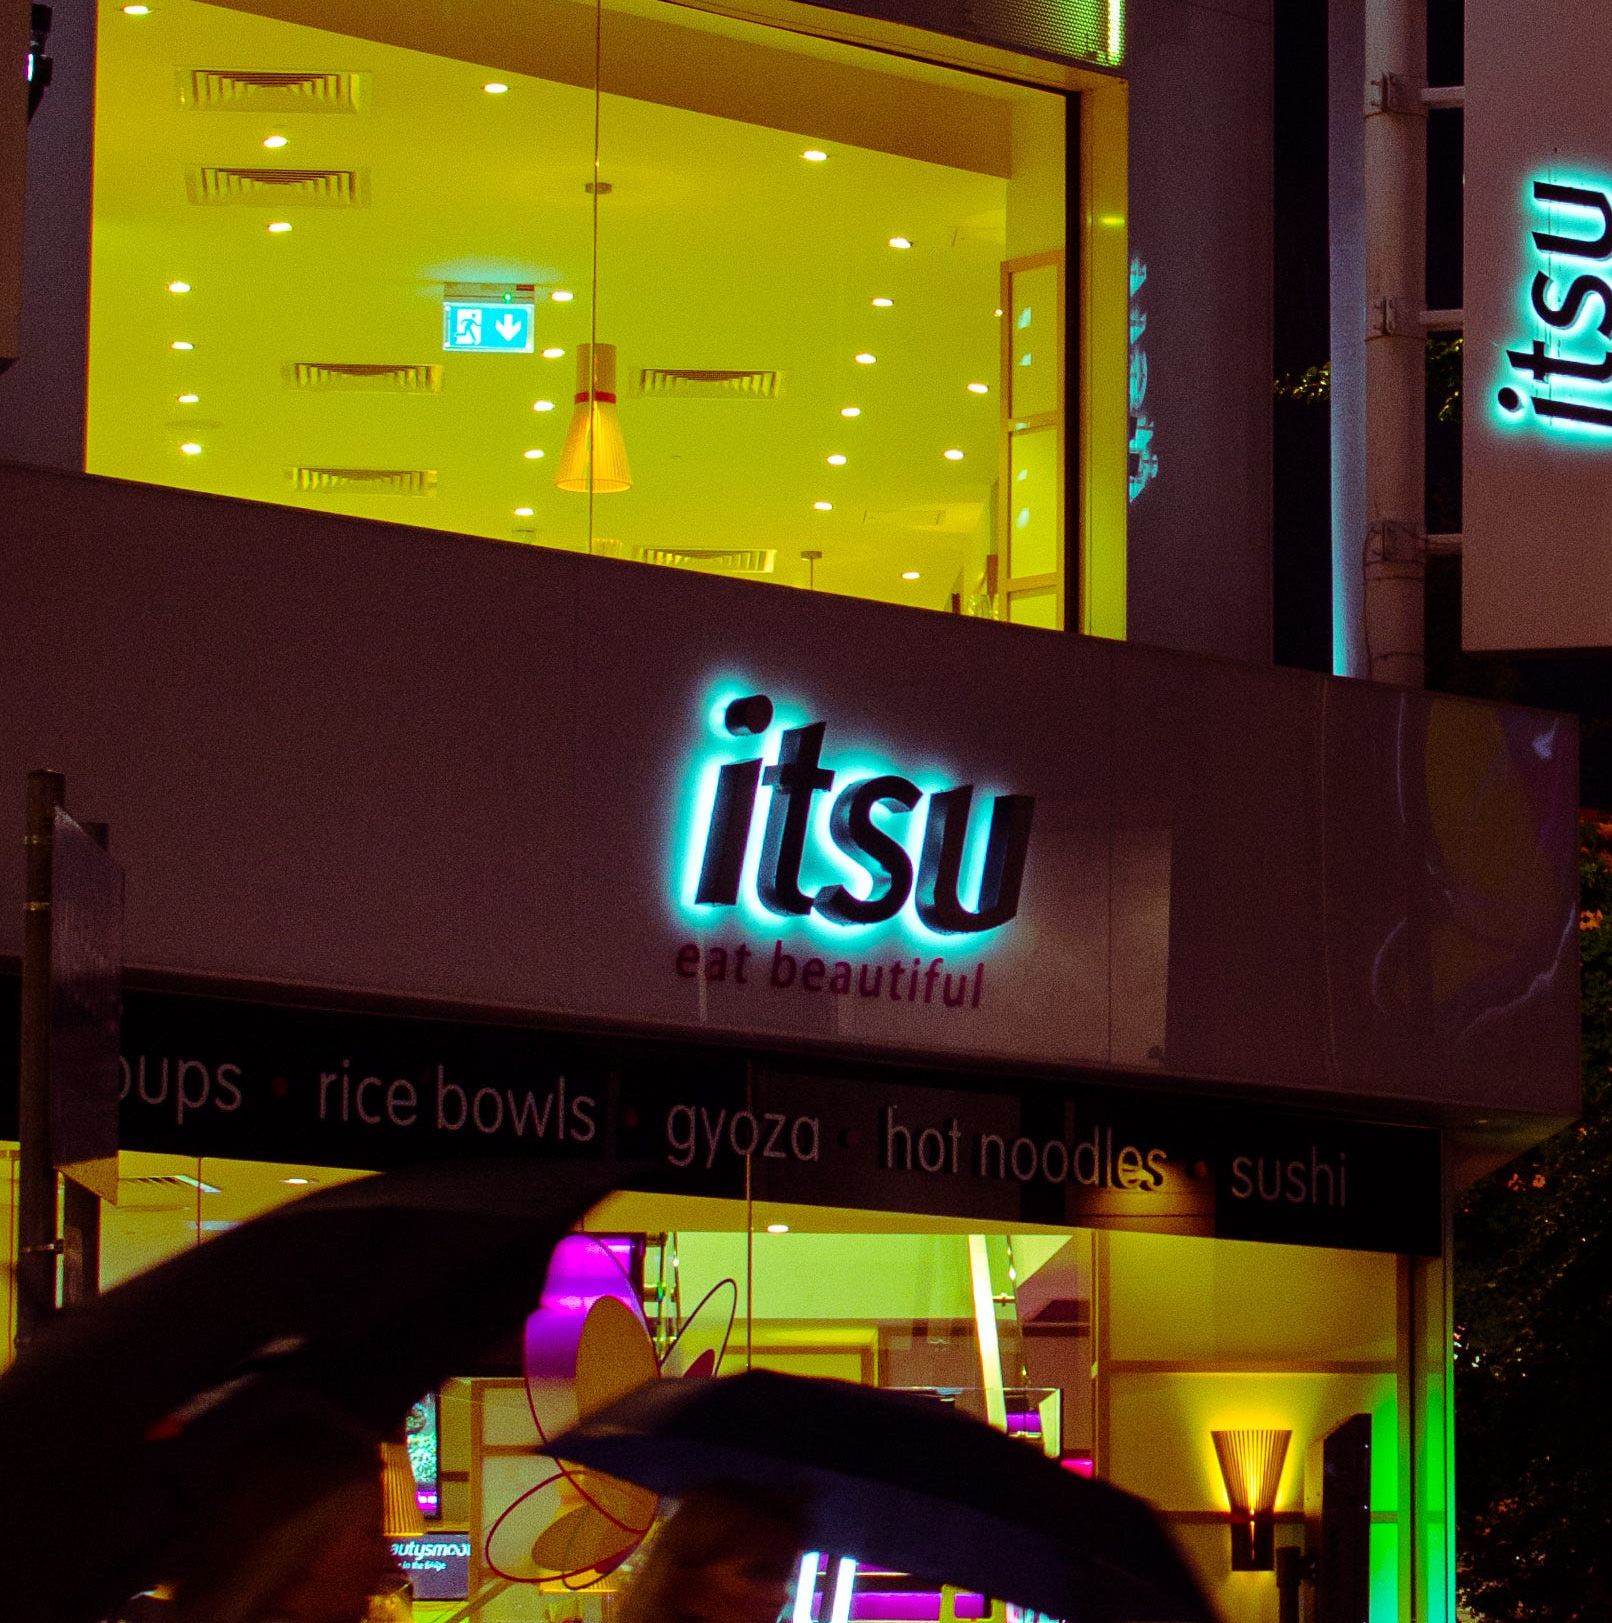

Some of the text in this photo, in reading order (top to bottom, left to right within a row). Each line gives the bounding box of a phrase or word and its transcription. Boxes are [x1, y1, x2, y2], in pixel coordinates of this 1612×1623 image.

[694, 694, 1036, 935] itsu
[675, 940, 985, 1009] eat beautiful
[318, 1057, 419, 1126] rice
[435, 1064, 597, 1143] bowls
[665, 1104, 821, 1169] gyoza
[884, 1105, 960, 1173] hot
[980, 1125, 1170, 1191] noodles
[1231, 1146, 1348, 1209] sushi
